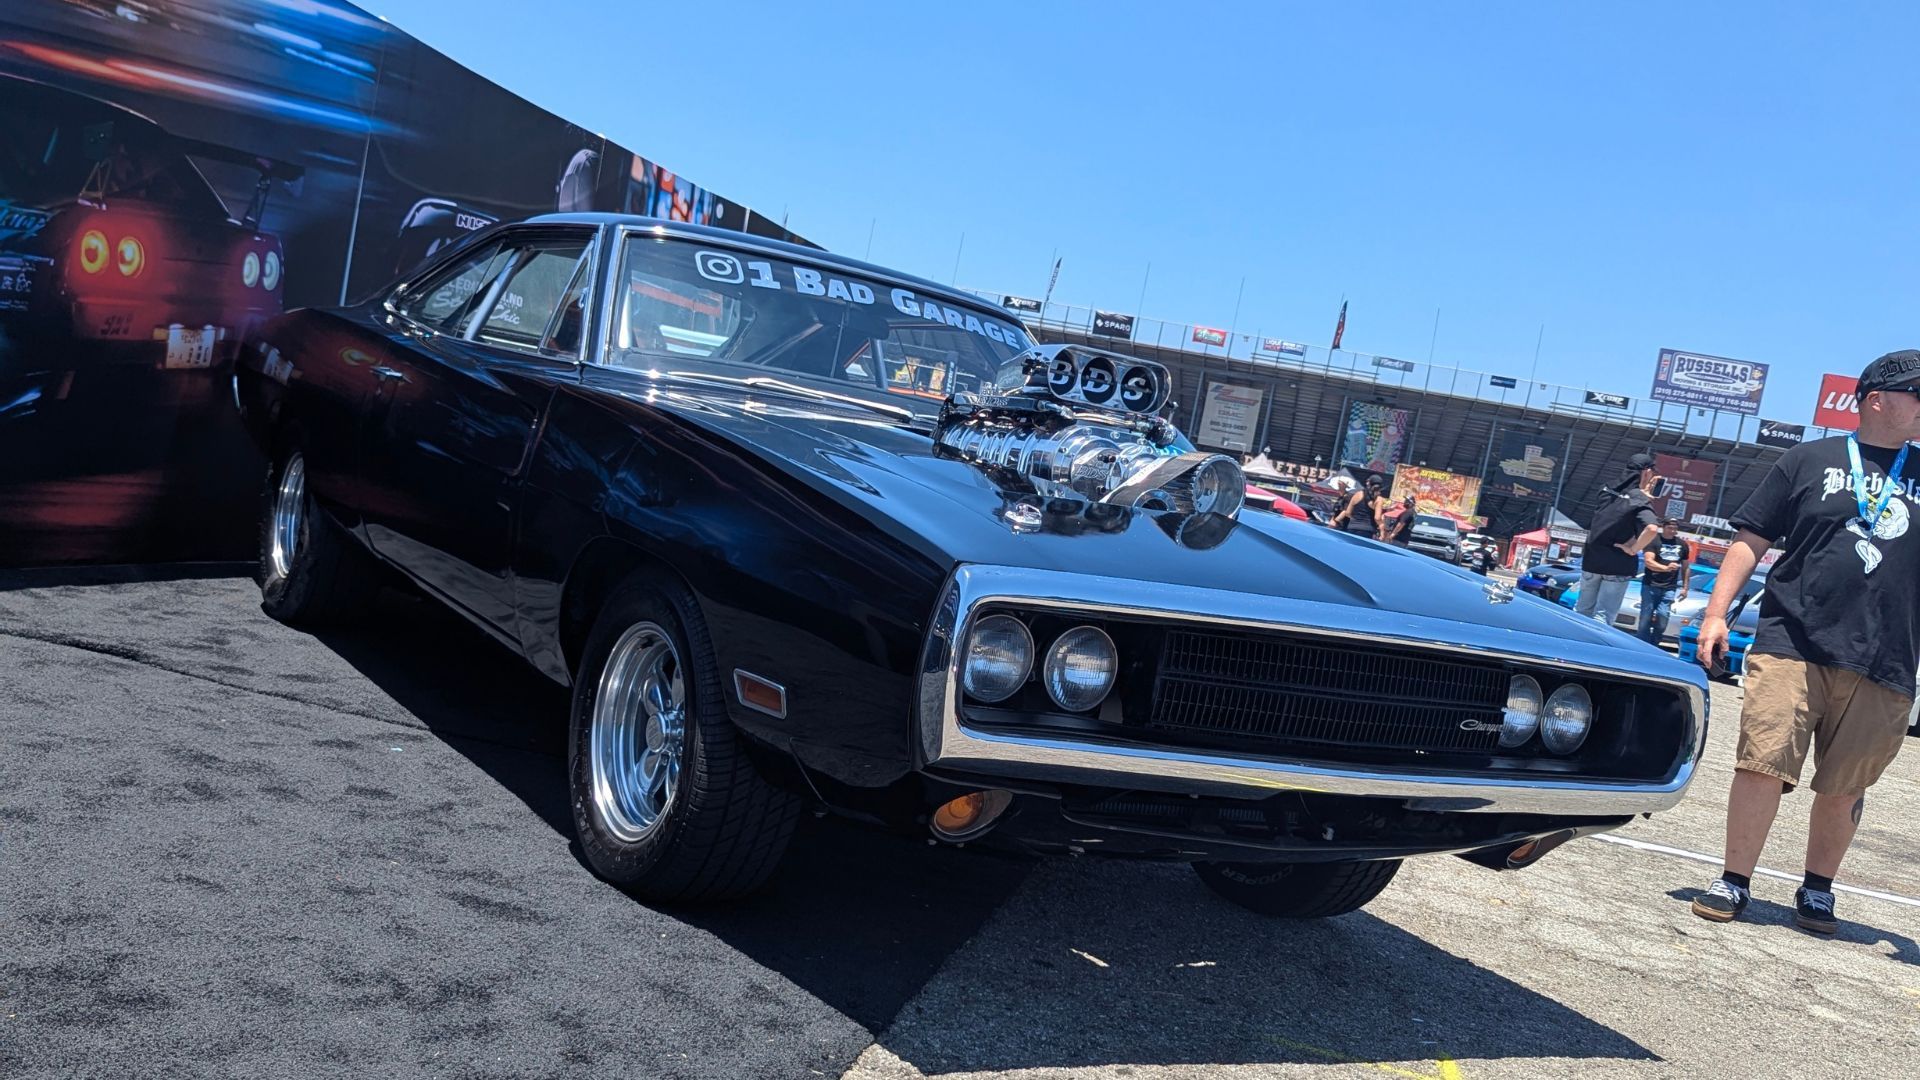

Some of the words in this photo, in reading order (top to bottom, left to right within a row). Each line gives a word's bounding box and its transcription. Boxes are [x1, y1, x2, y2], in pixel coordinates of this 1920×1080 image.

[748, 262, 781, 290] 1
[1675, 357, 1750, 384] RUSSELLS
[1703, 382, 1732, 391] STORAGE
[1822, 467, 1884, 501] Bich
